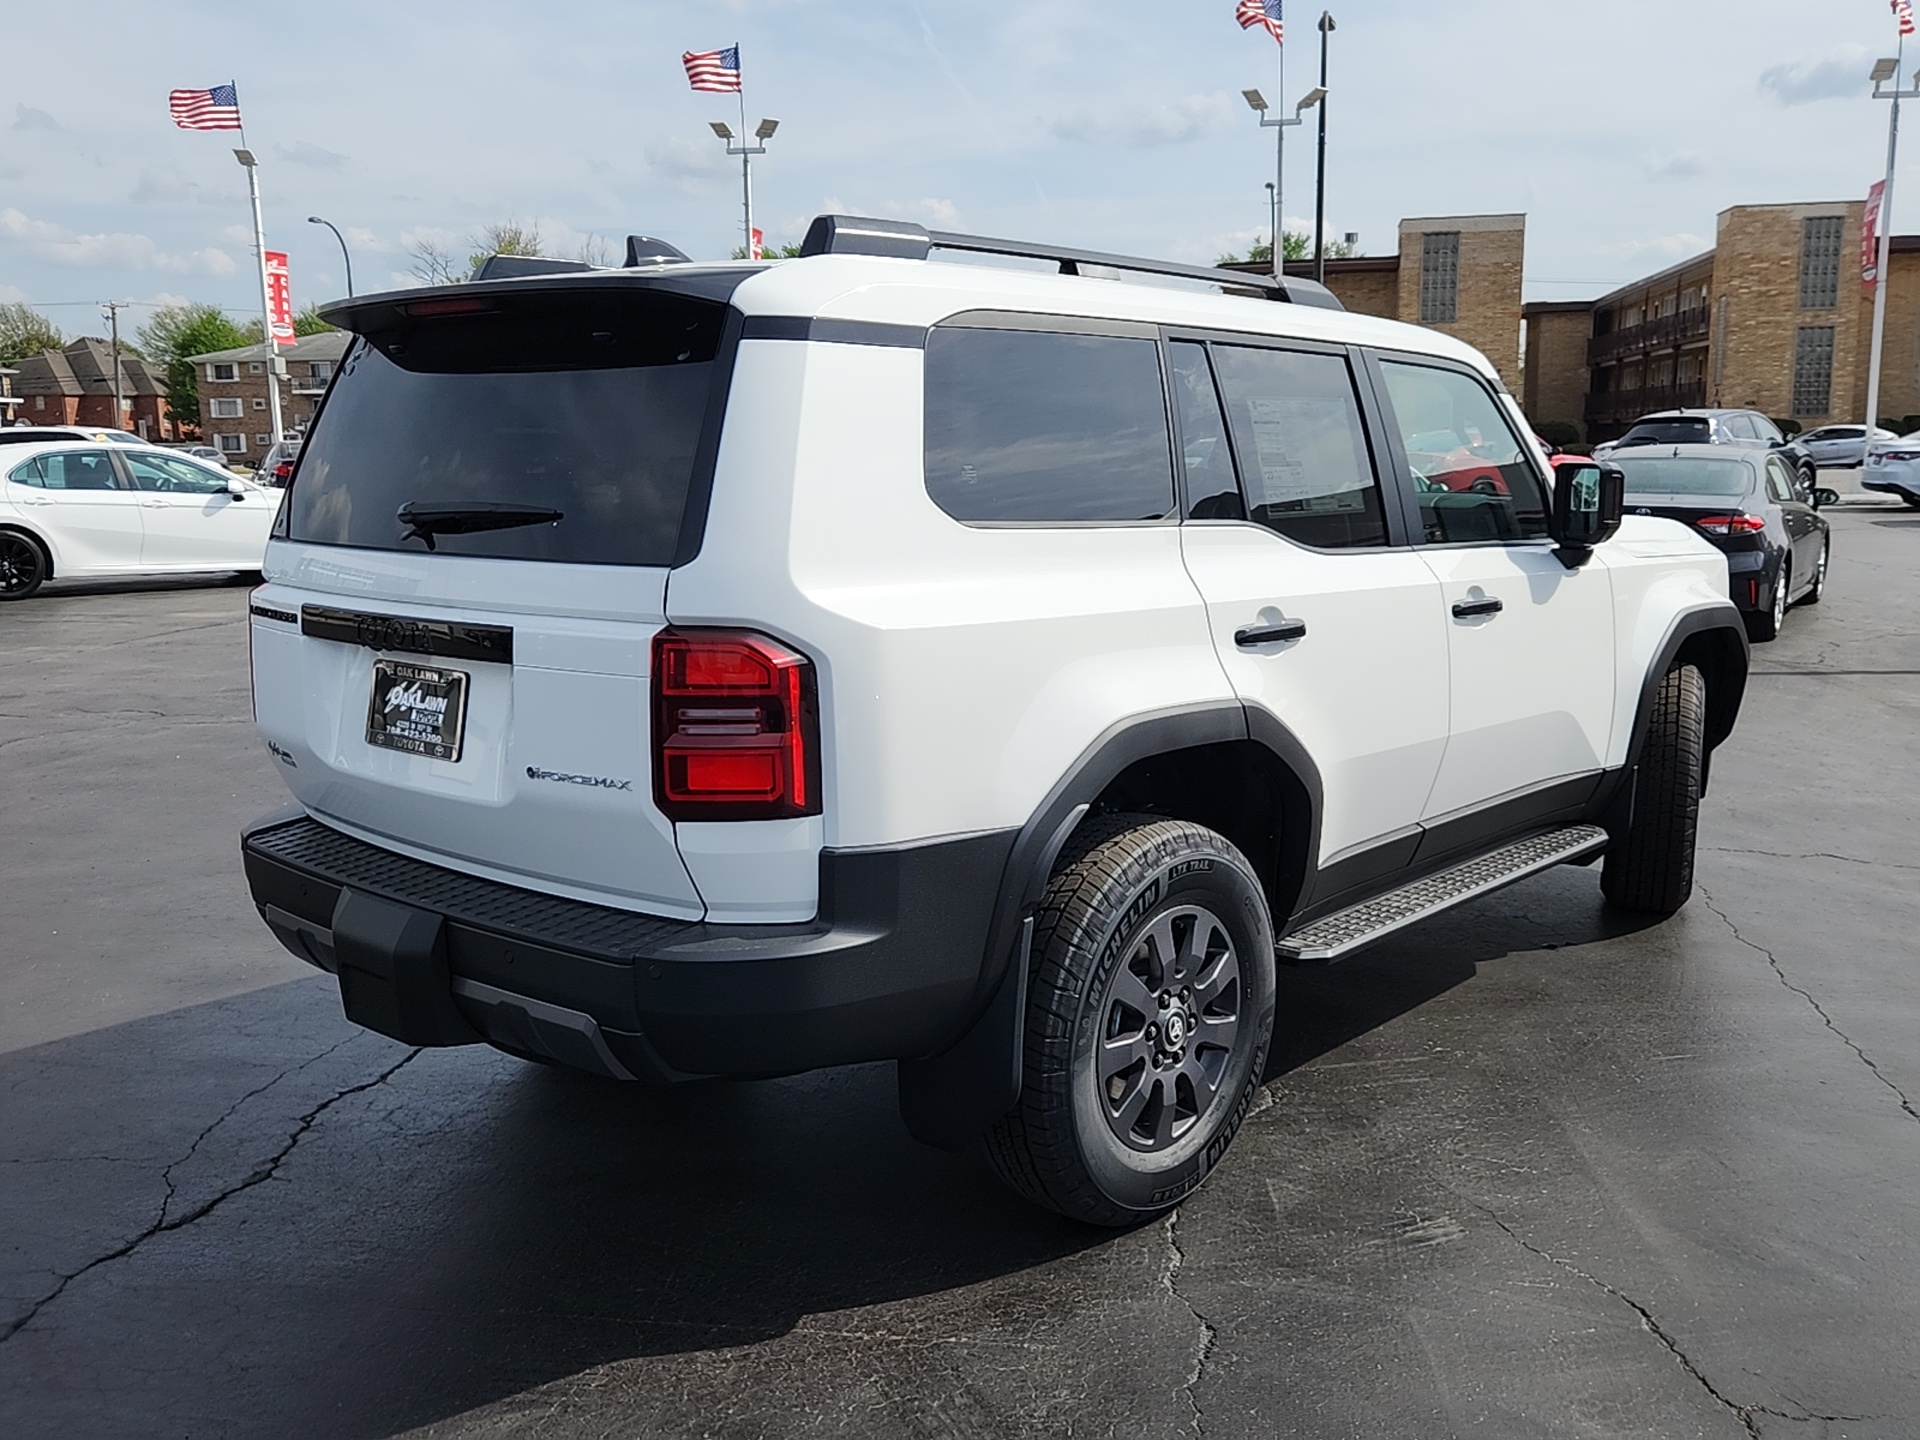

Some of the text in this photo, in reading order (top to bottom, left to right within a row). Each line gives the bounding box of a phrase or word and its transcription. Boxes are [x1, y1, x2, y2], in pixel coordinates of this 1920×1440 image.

[280, 276, 290, 324] CARS
[355, 615, 433, 650] TOYOTA
[396, 666, 439, 682] OAK LAWN
[393, 736, 425, 752] TOYOTA
[1089, 884, 1156, 1009] MICHELIN
[1210, 1049, 1264, 1166] MICHELIN
